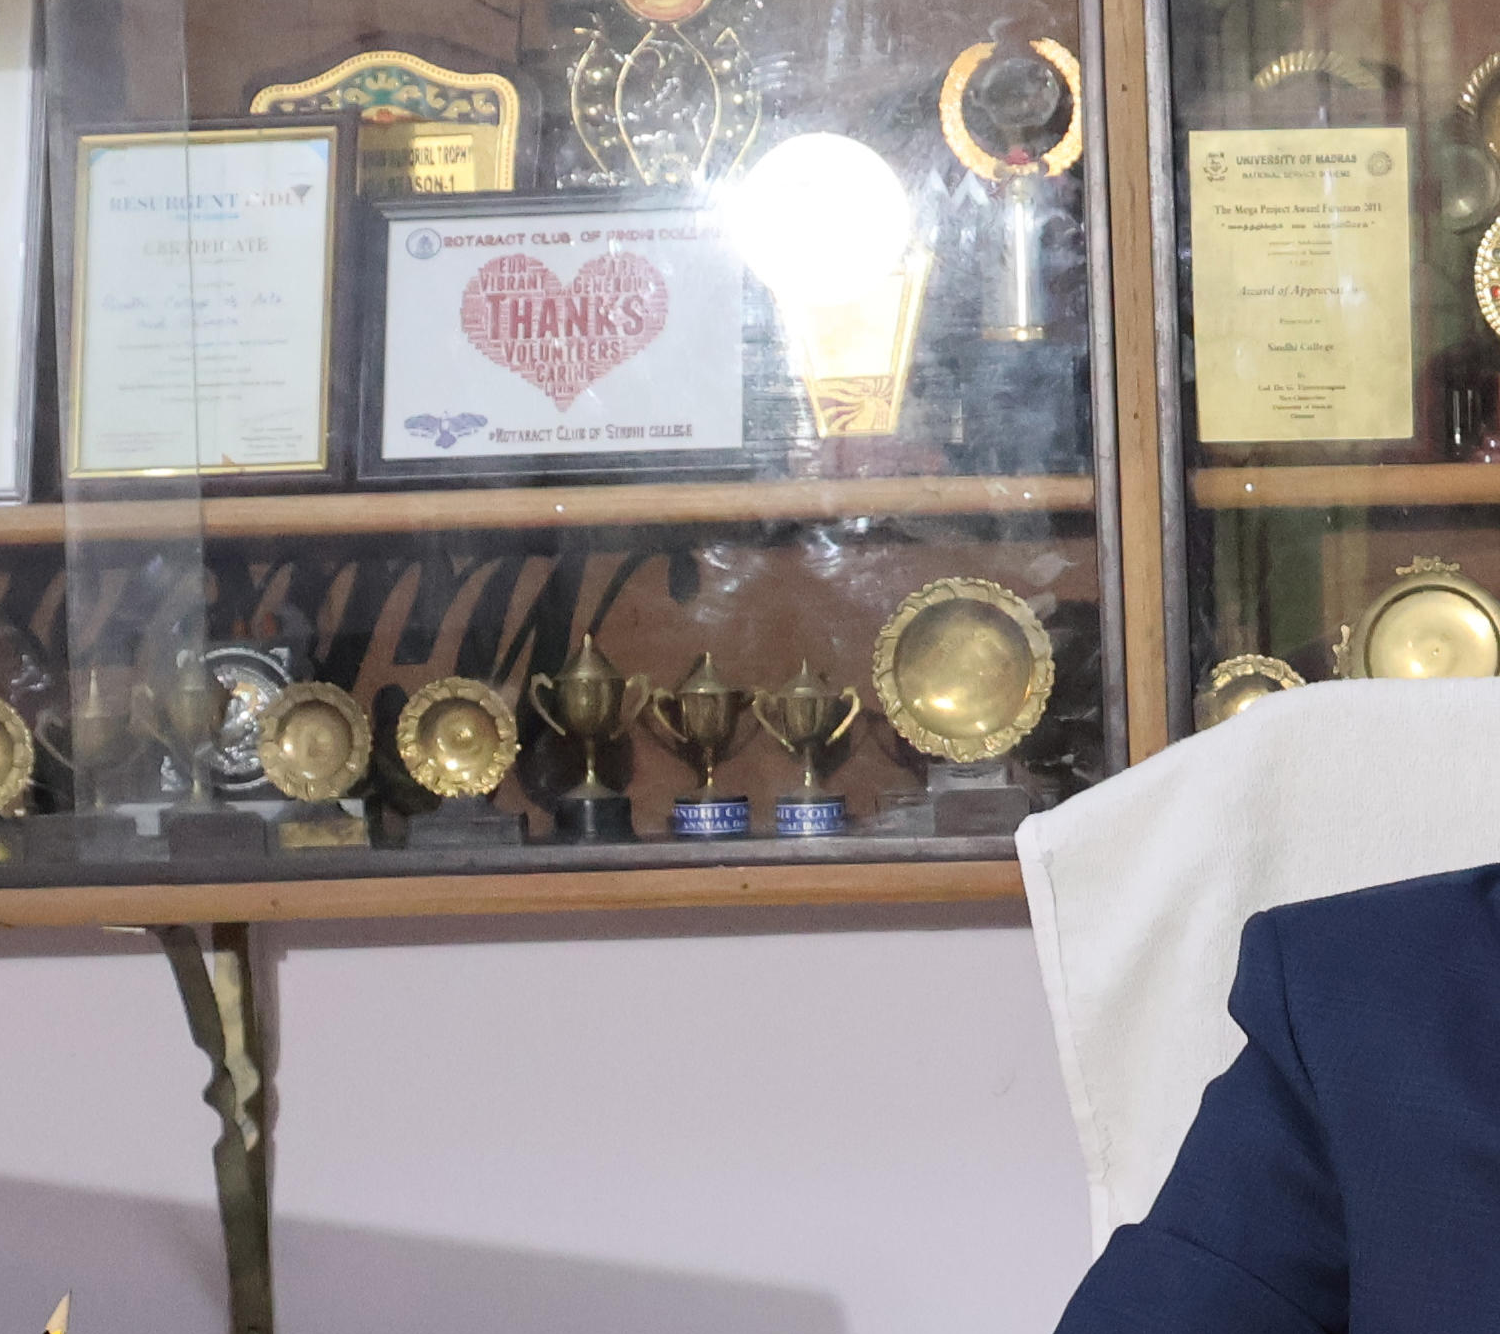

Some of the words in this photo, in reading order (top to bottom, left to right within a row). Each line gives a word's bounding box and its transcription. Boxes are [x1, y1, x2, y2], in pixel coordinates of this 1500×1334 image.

[1236, 154, 1295, 166] UNIVERSITY
[1299, 154, 1312, 165] OF
[1315, 153, 1358, 164] MADRAS
[109, 192, 239, 213] RESURGENT
[1214, 204, 1232, 215] The
[1235, 204, 1258, 216] Mega
[1260, 203, 1291, 216] Project
[1293, 203, 1320, 214] Award
[143, 236, 269, 256] CERTIFICATE
[442, 232, 525, 248] ROTARACT
[531, 231, 571, 245] CLUB
[580, 230, 601, 243] OF
[478, 272, 545, 292] VIBRANT
[484, 293, 648, 342] THANKS
[501, 341, 621, 365] VOLUNTEERS
[1268, 342, 1298, 352] Sindhi
